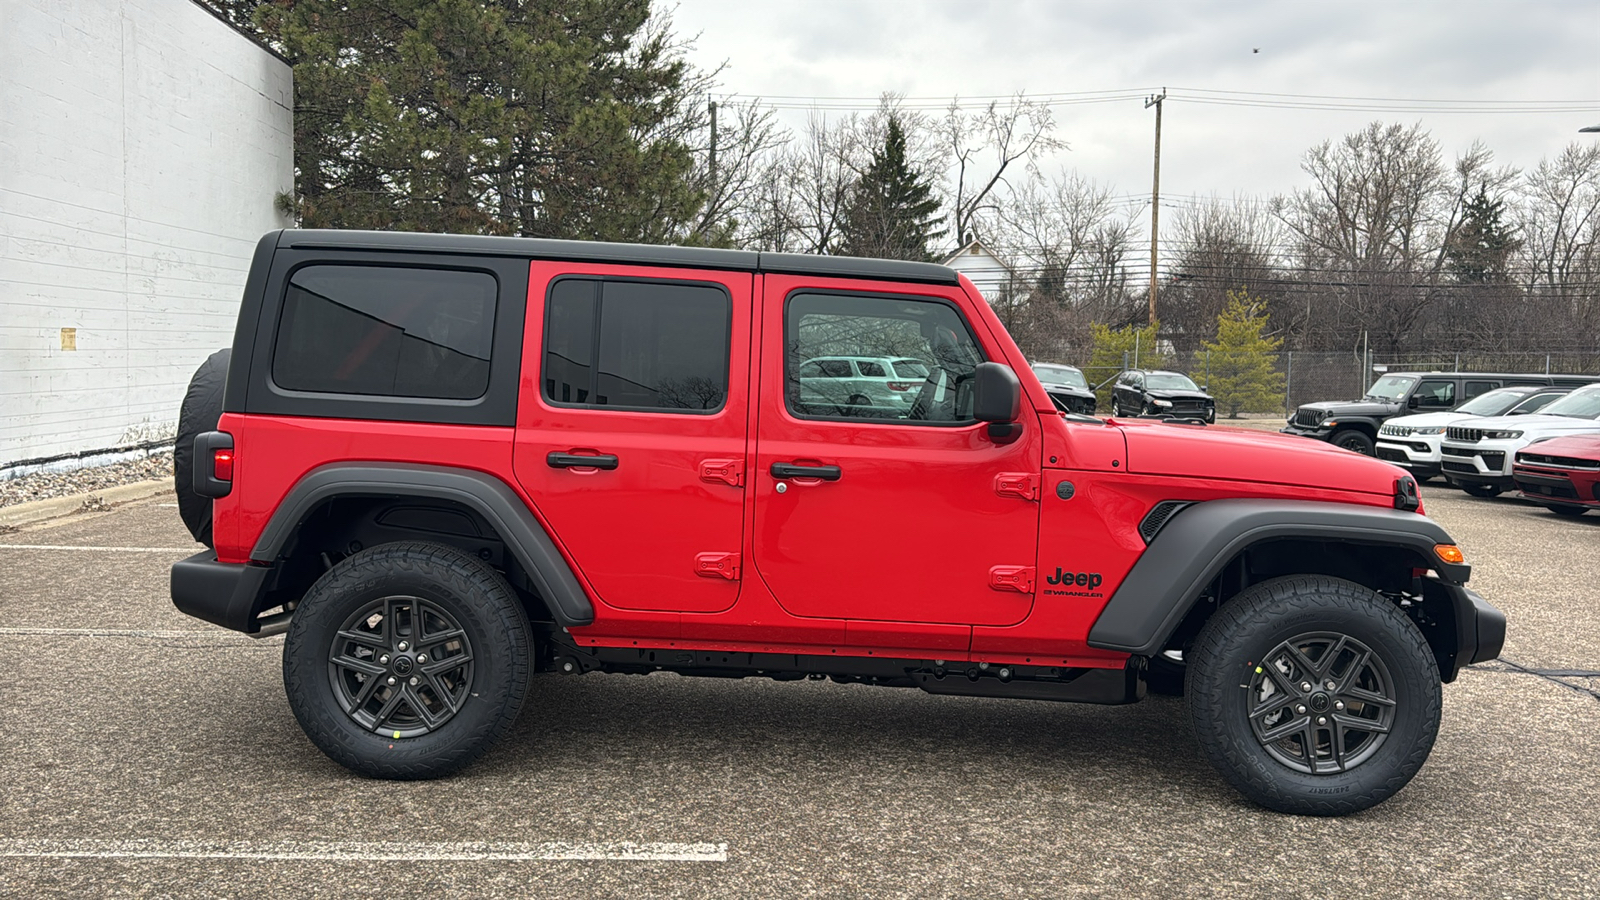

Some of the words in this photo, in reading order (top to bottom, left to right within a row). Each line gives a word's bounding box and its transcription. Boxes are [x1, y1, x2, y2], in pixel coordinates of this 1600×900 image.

[1047, 566, 1102, 590] Jeep
[1053, 589, 1103, 598] WRANGLER
[1309, 786, 1350, 794] 245/75R17
